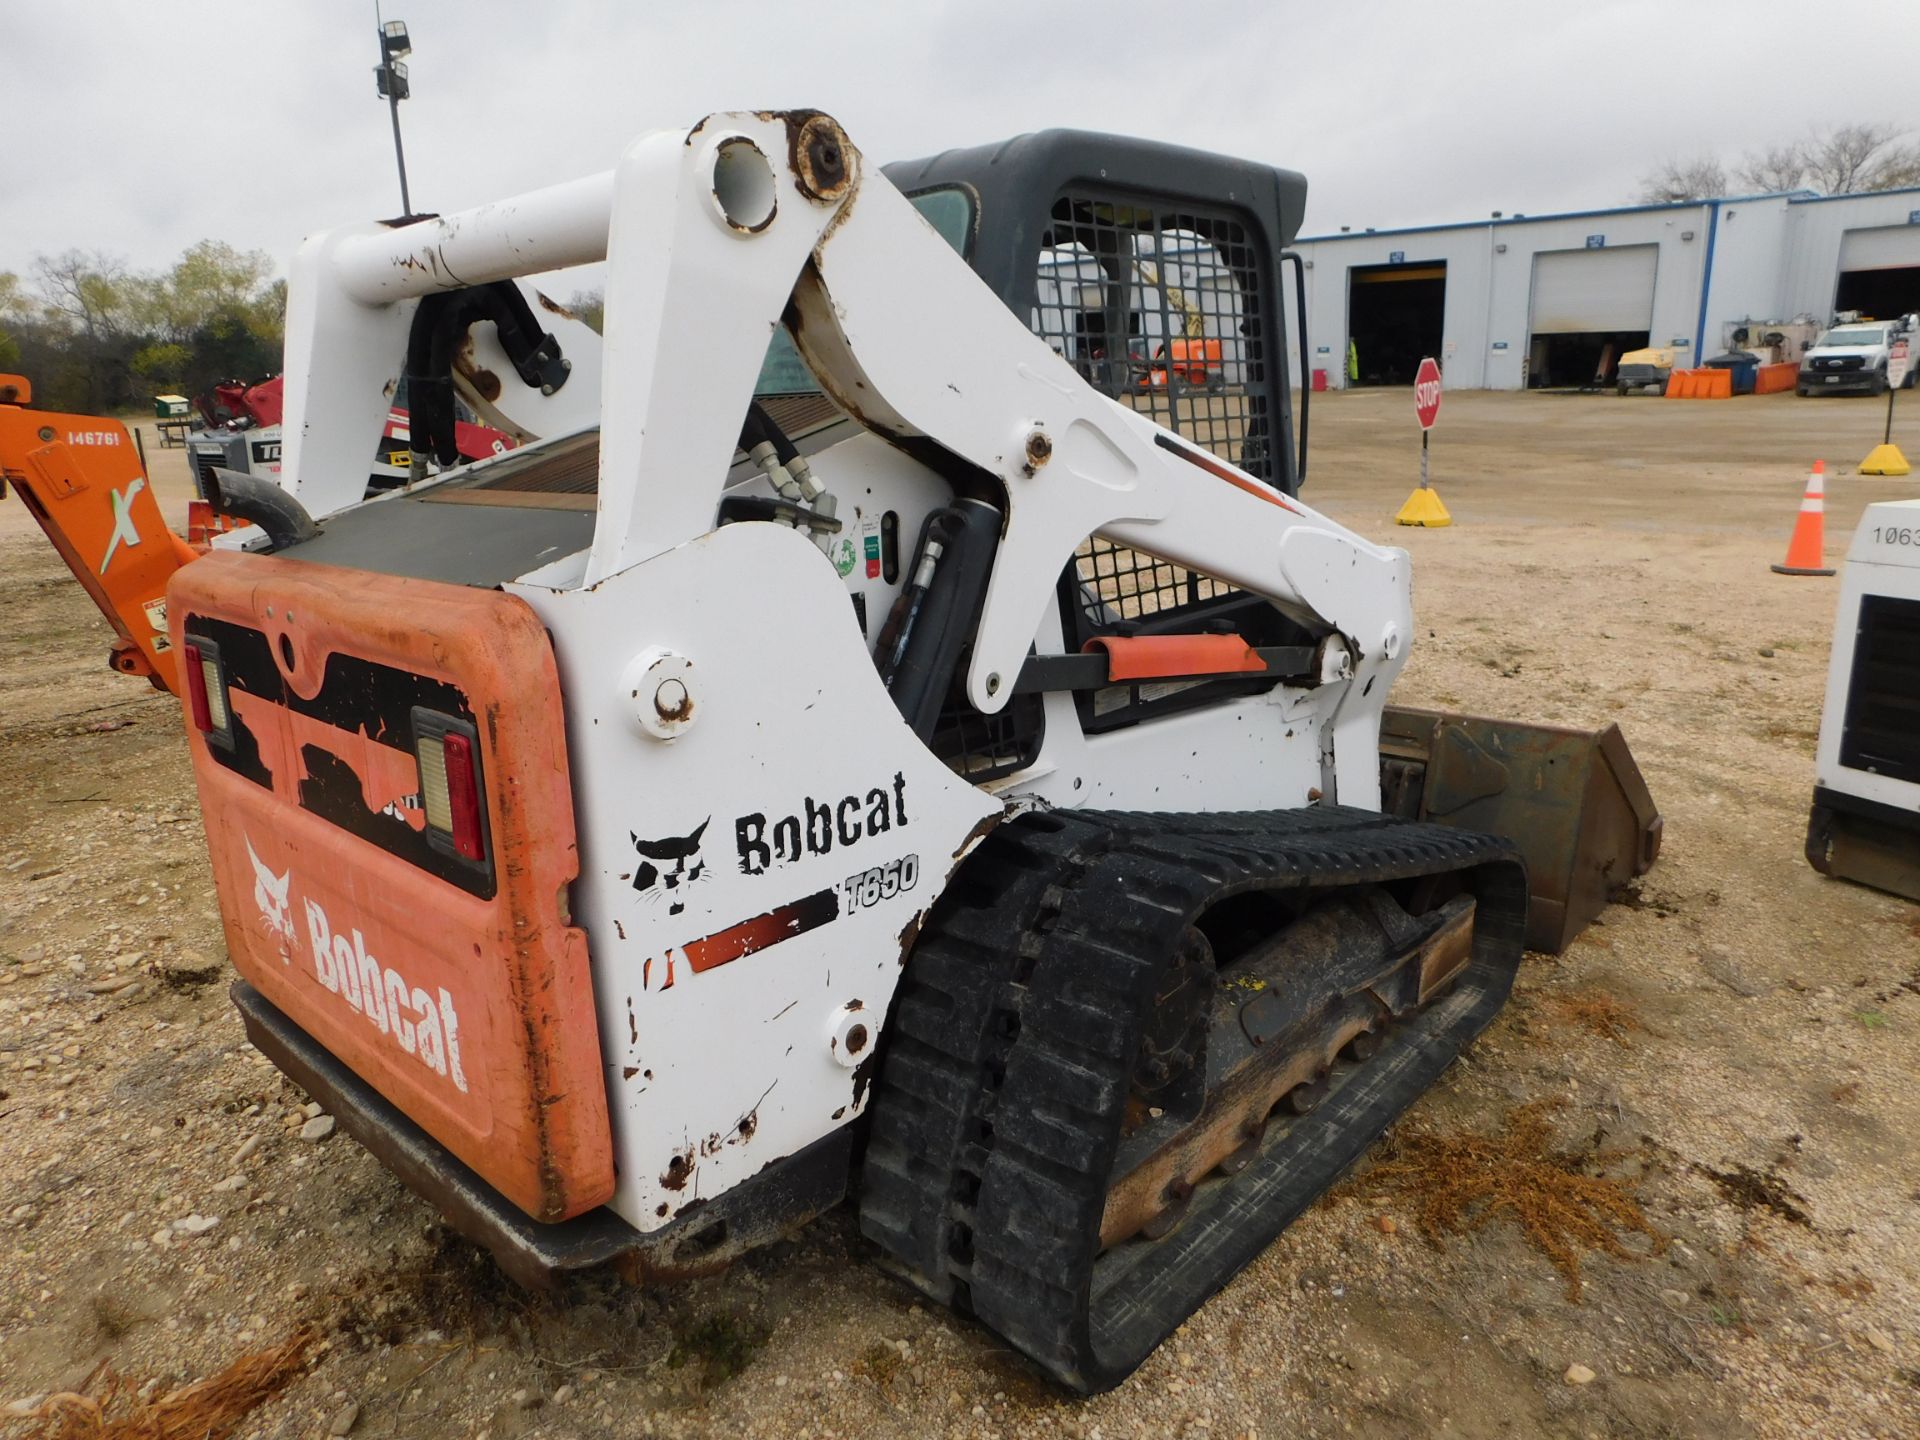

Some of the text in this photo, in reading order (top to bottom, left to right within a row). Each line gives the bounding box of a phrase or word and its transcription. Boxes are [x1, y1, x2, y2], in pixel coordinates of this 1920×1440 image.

[1416, 380, 1439, 410] STOP
[67, 431, 119, 446] 146761
[735, 771, 909, 876] Bobcat
[844, 853, 920, 916] T650
[303, 896, 470, 1094] Bobcat
